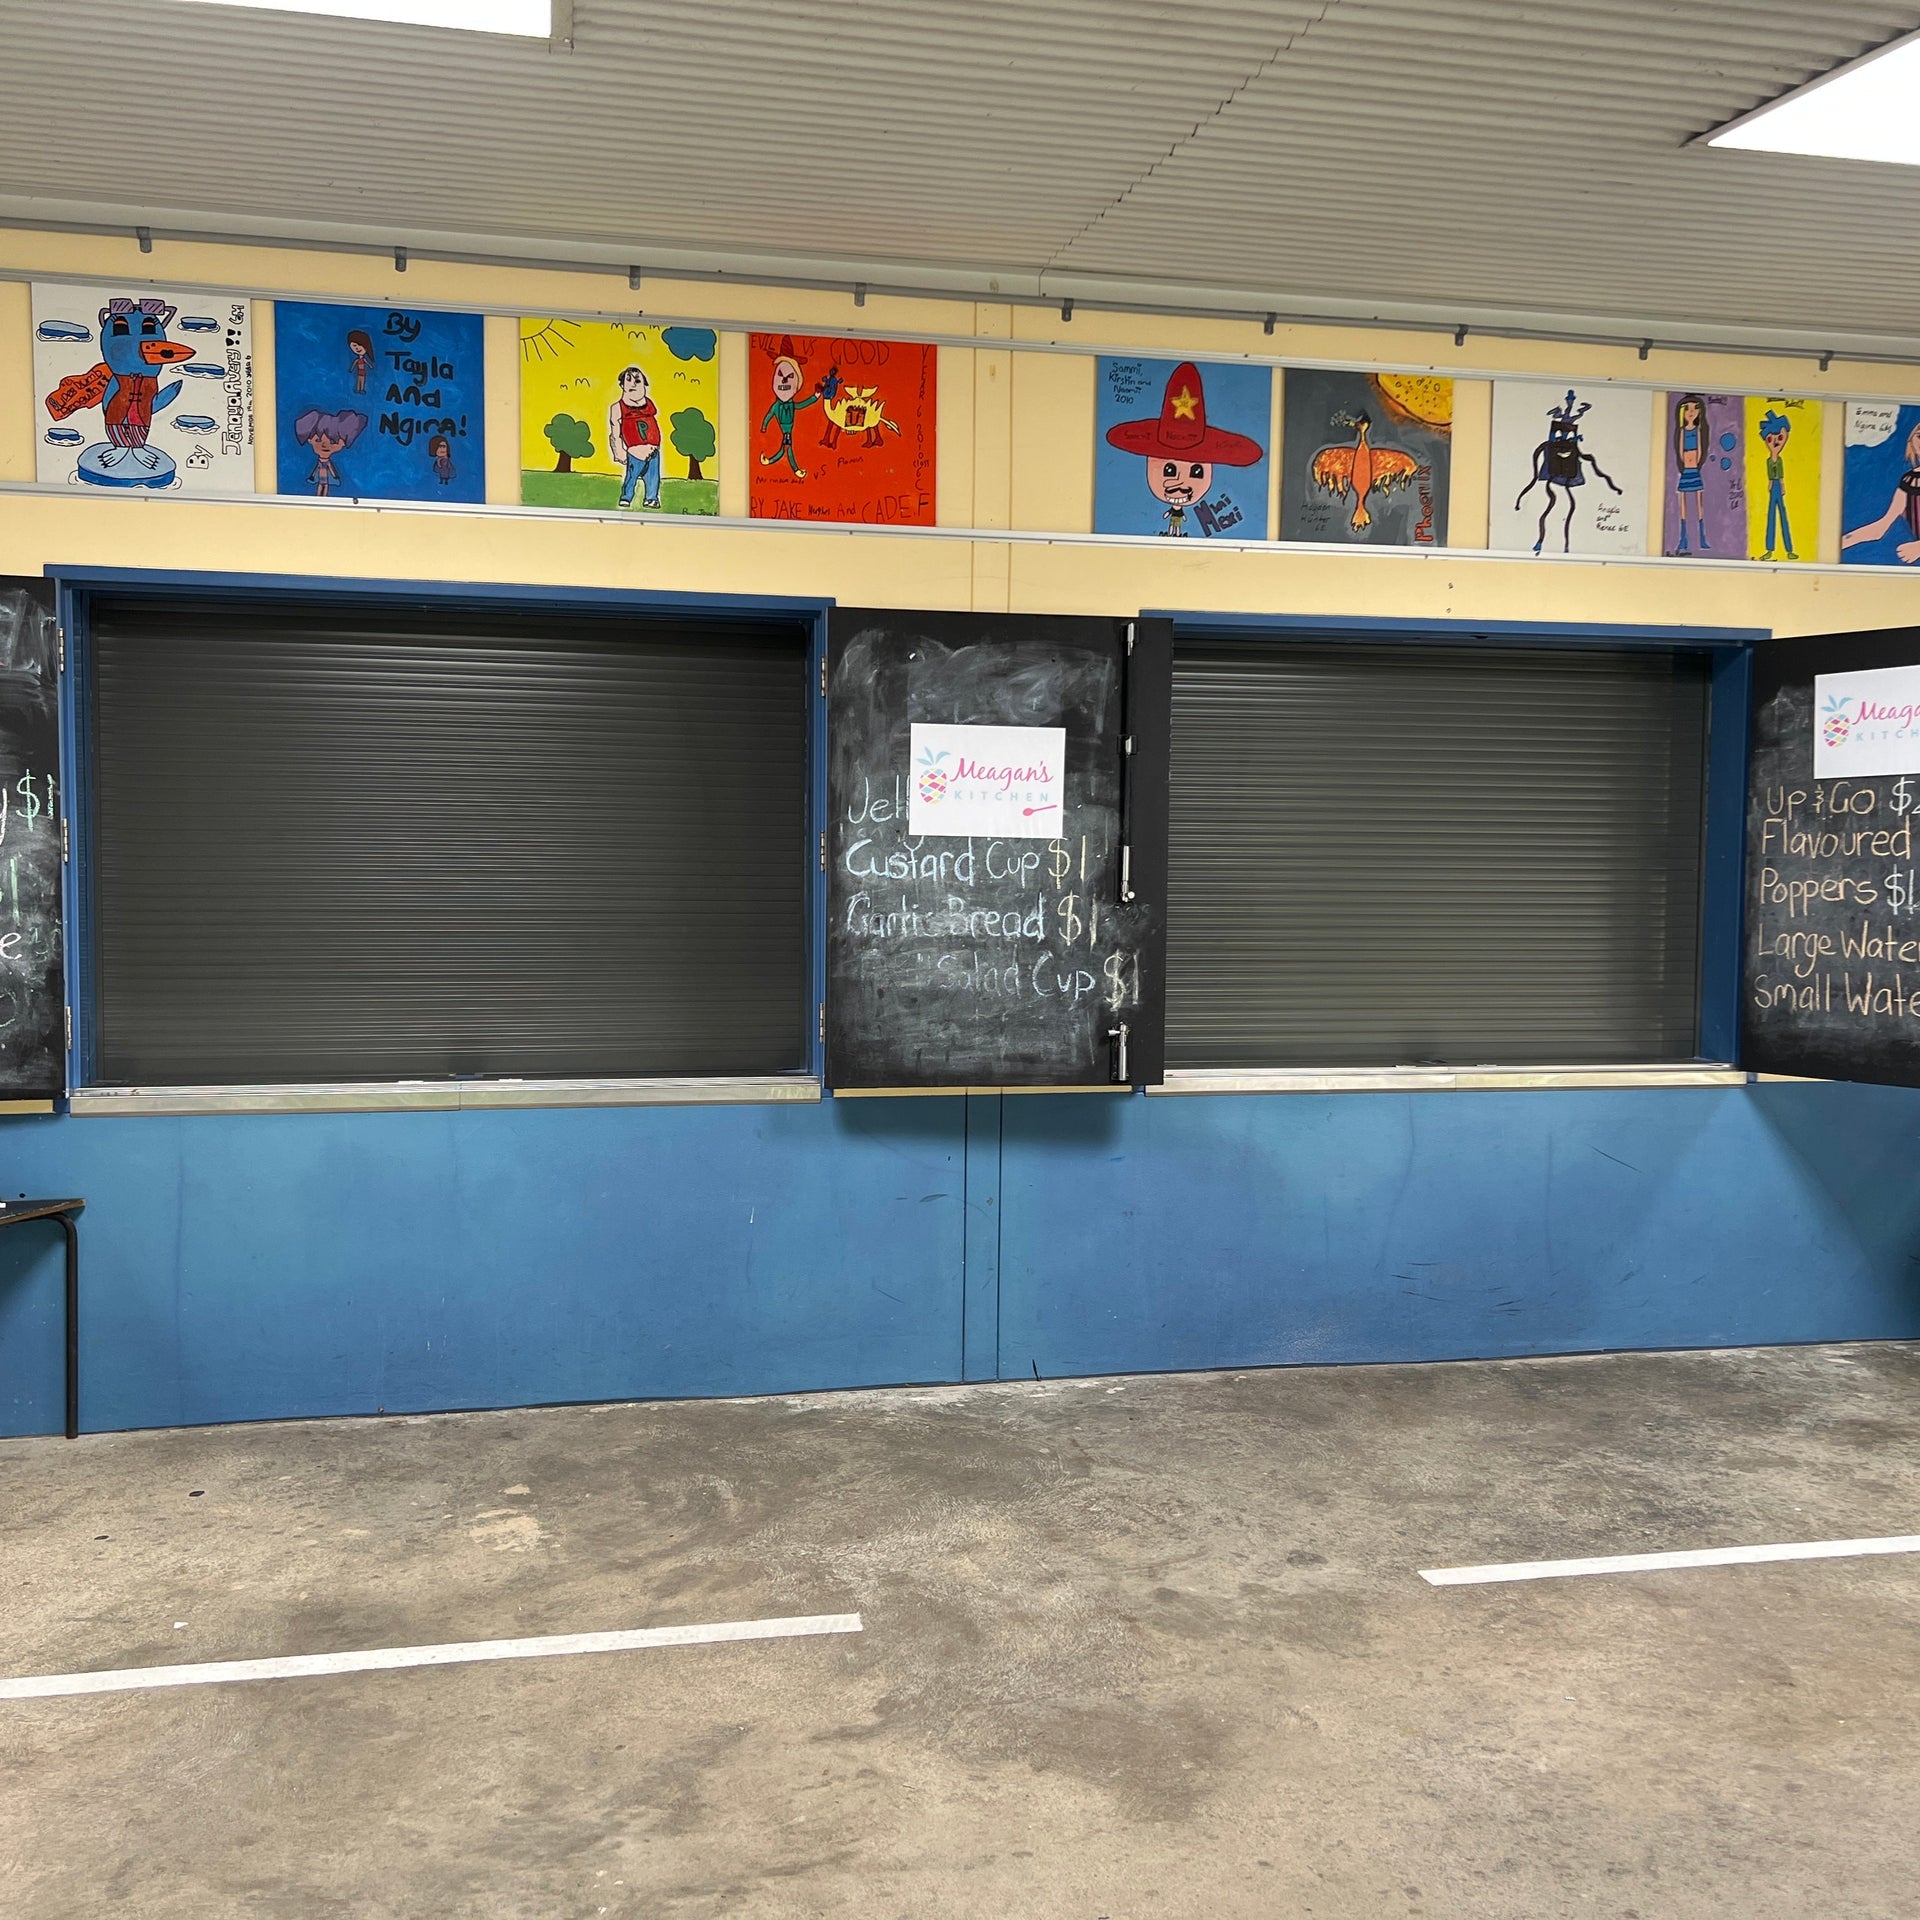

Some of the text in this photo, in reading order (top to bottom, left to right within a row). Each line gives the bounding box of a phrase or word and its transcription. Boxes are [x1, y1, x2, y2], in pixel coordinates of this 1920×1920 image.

[382, 311, 421, 342] By
[385, 351, 454, 387] Tayla
[830, 337, 890, 366] GOOD
[1114, 393, 1134, 404] 2010
[637, 420, 649, 441] P
[186, 445, 214, 469] By
[771, 499, 803, 519] JAKE
[950, 757, 1053, 791] Meagan's
[16, 768, 54, 833] $1
[954, 790, 1049, 801] KITCHEN
[1761, 815, 1911, 860] Flavoured
[846, 835, 1087, 890] Custard Cup $1
[1761, 867, 1878, 918] Poppers
[947, 892, 1046, 942] Bread
[1057, 890, 1098, 950] $1
[1758, 919, 1920, 979] Large Wate
[1754, 974, 1831, 1013] Small
